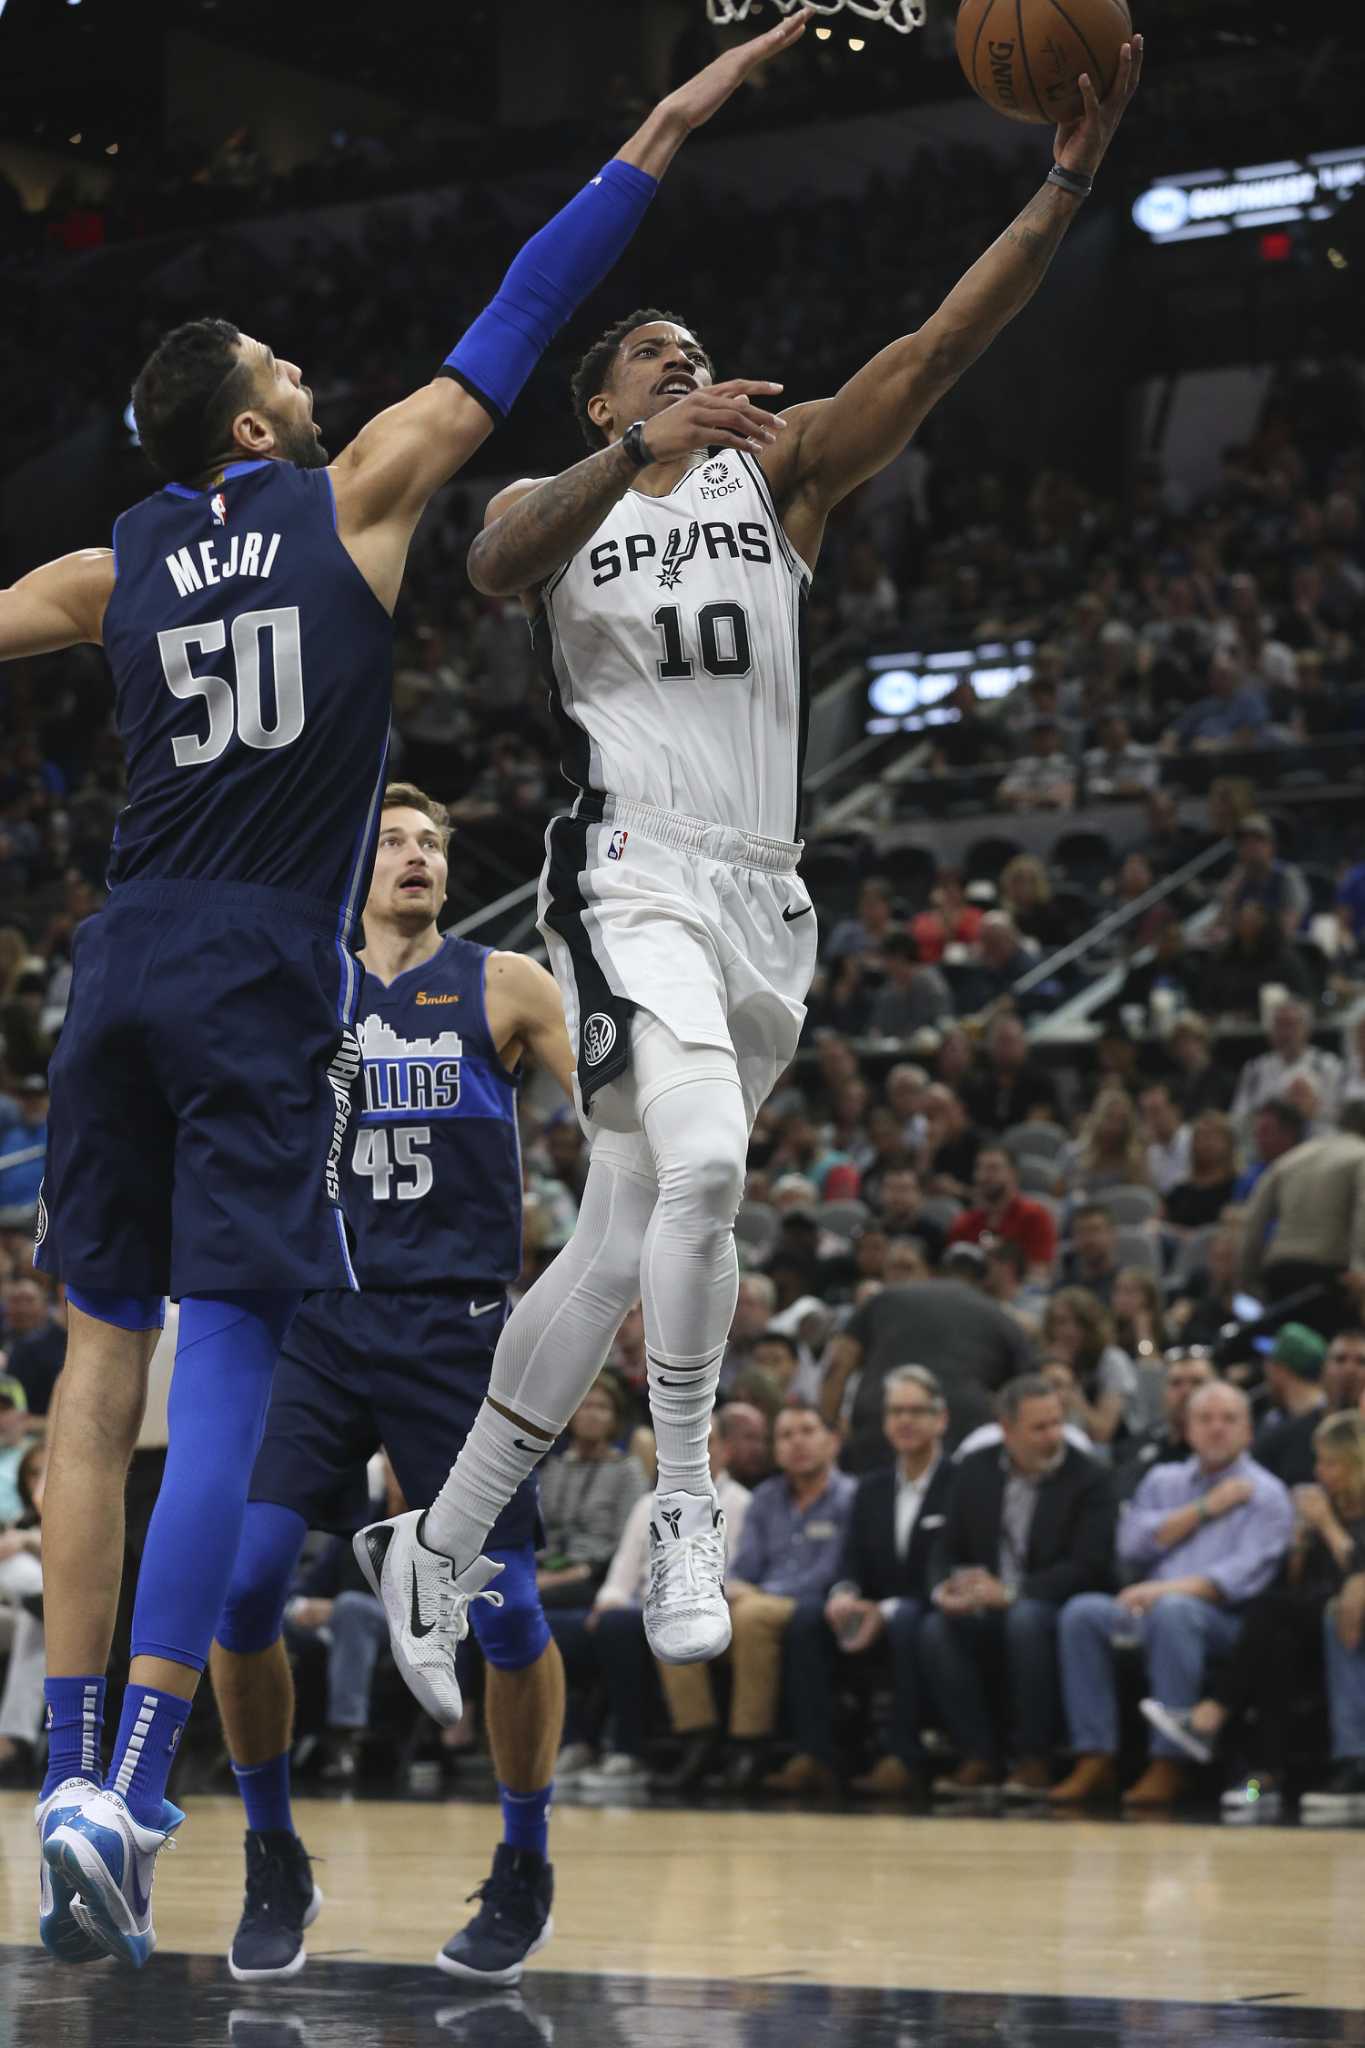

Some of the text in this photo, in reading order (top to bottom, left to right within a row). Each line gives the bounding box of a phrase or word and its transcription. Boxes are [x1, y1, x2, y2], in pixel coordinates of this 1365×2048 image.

[699, 477, 744, 500] Frost
[165, 532, 281, 598] MEJRI
[590, 521, 772, 590] SPURS
[651, 600, 752, 681] 10
[157, 606, 305, 767] 50
[361, 1061, 461, 1113] LLAS
[352, 1126, 433, 1200] 45
